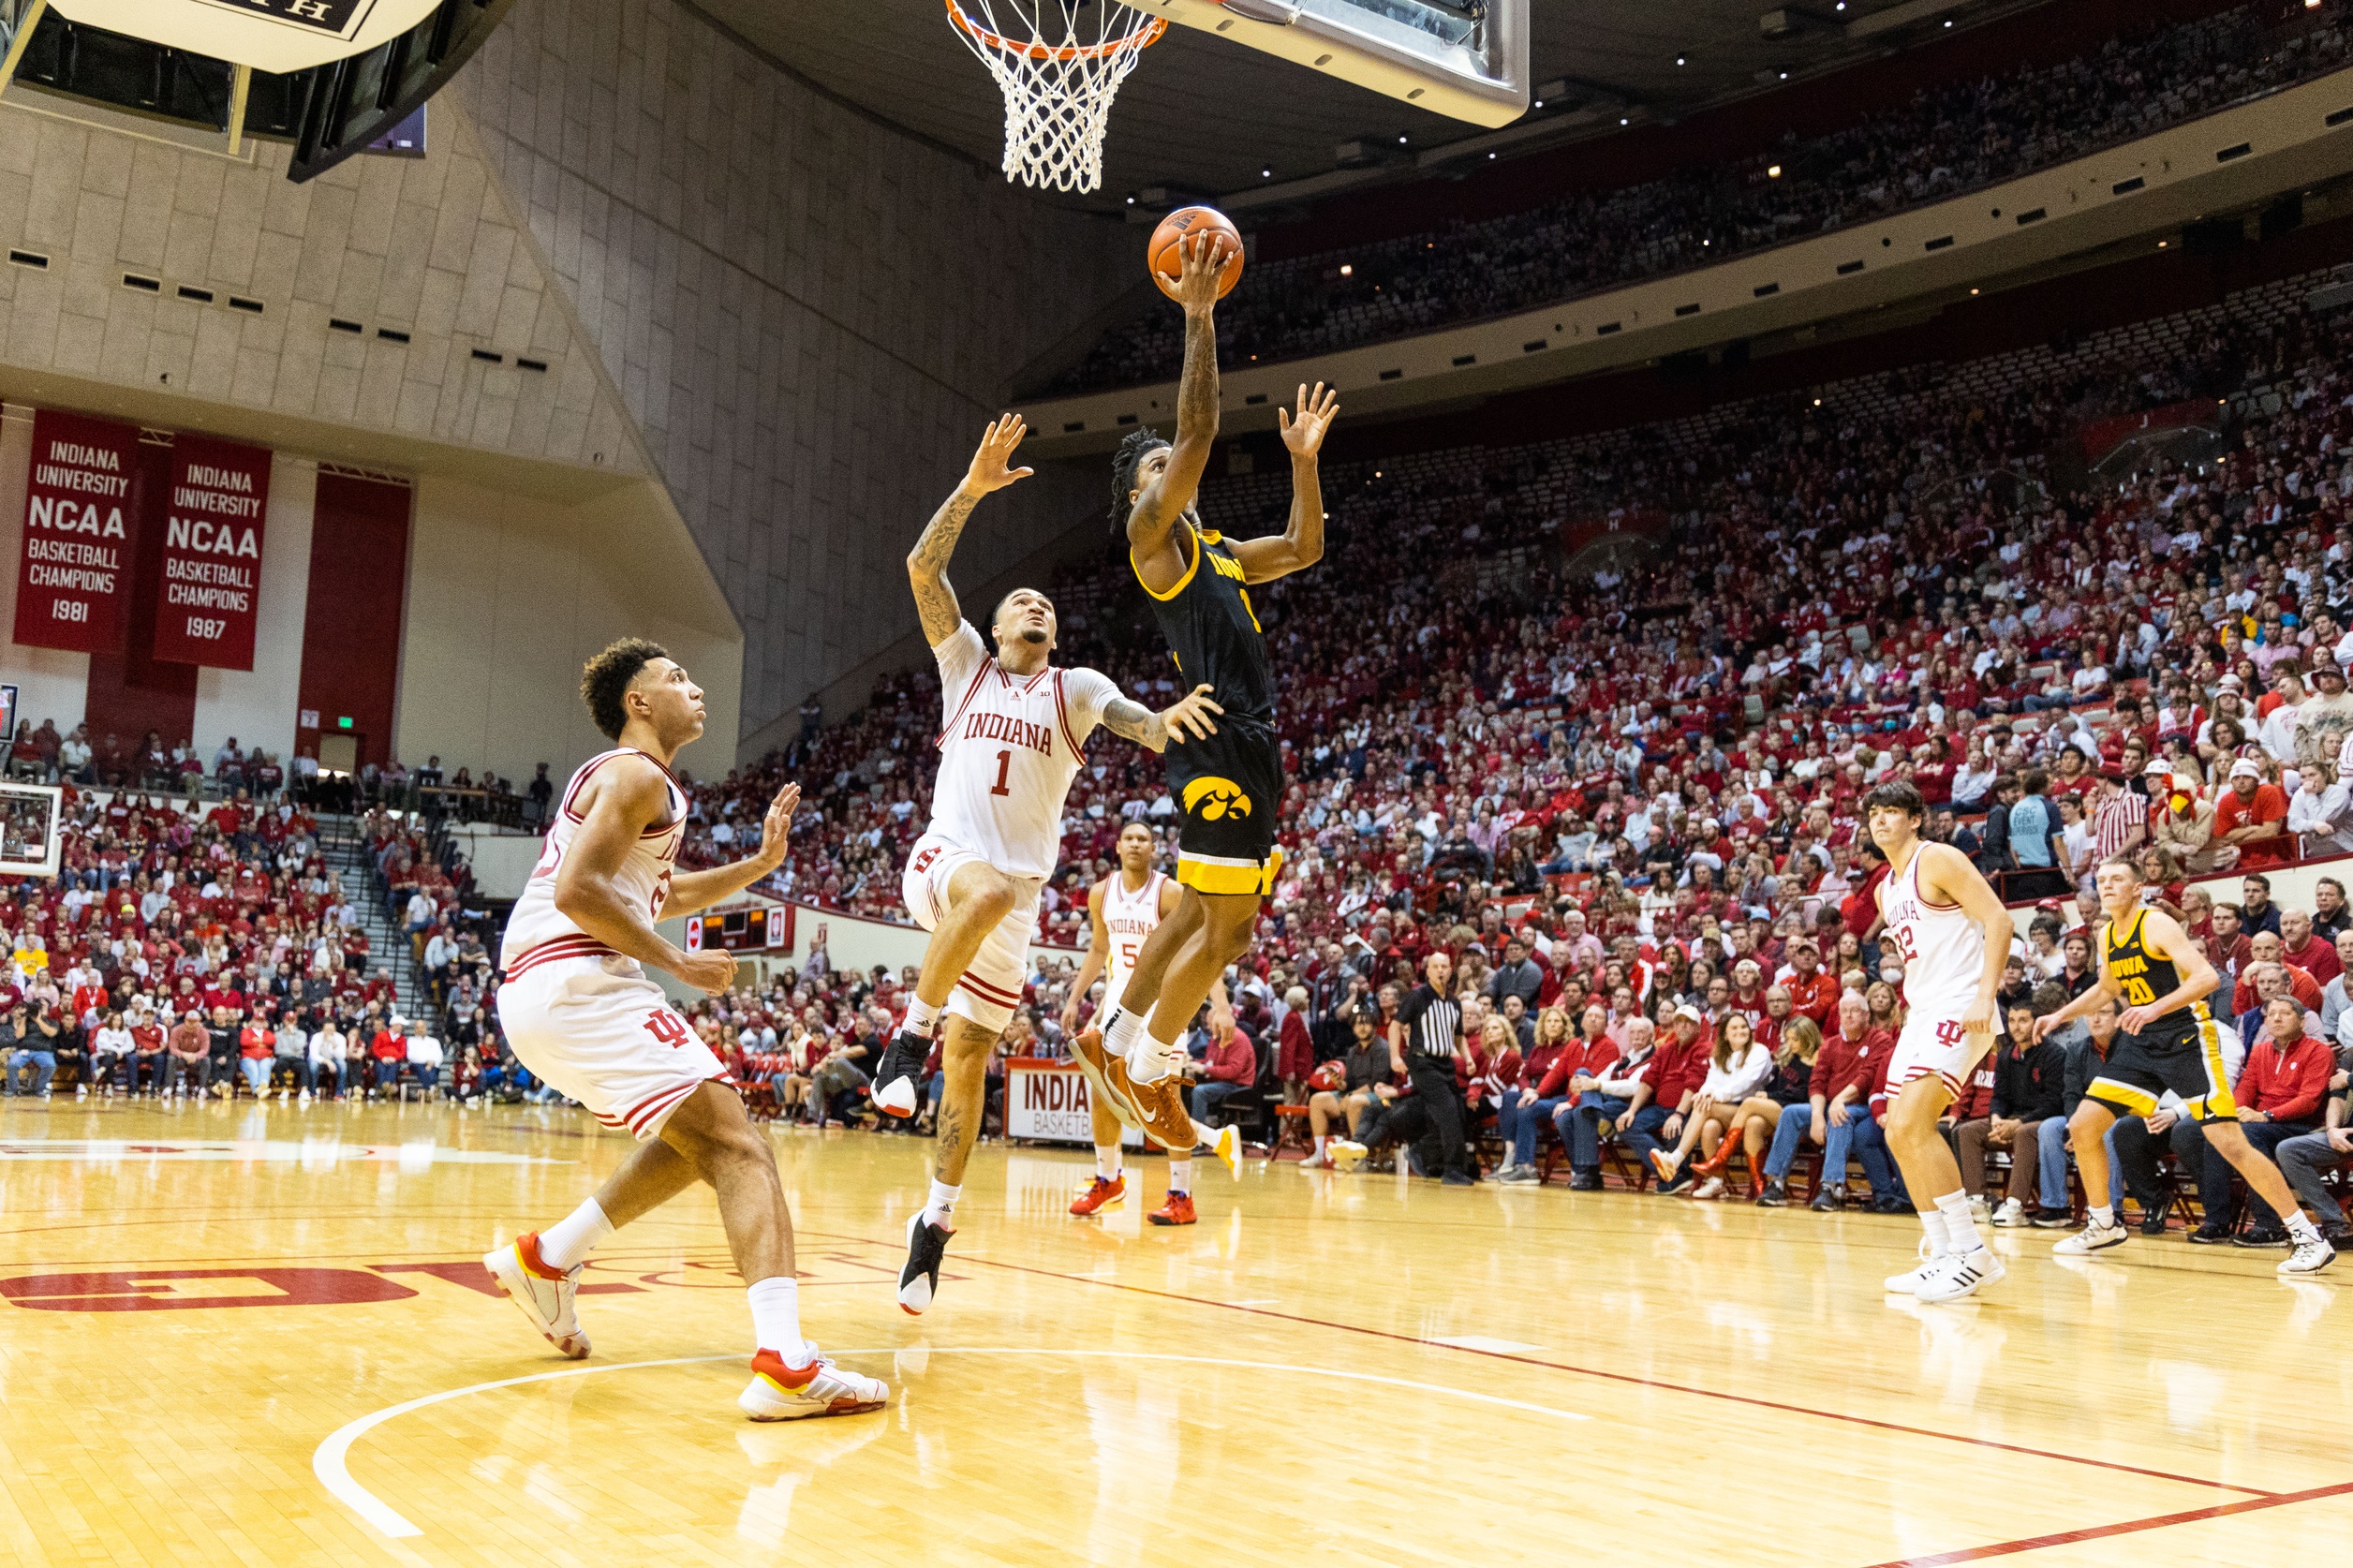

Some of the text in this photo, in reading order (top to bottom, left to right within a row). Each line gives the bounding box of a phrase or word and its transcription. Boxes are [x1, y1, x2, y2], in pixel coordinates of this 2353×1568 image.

[50, 439, 119, 471] INDIANA
[36, 464, 128, 497] UNIVERSITY
[187, 464, 252, 494] INDIANA
[28, 495, 126, 540] NCAA
[174, 486, 260, 518] UNIVERSITY
[167, 516, 258, 559] NCAA
[27, 538, 120, 570] BASKETBALL
[29, 564, 115, 595] CHAMPIONS
[166, 557, 253, 589] BASKETBALL
[52, 599, 88, 623] 1981
[168, 583, 249, 613] CHAMPIONS
[186, 616, 226, 640] 1987
[964, 712, 1052, 758] INDIANA
[990, 749, 1012, 797] 1
[1122, 942, 1138, 969] 5
[1894, 925, 1918, 965] 32
[2109, 954, 2150, 979] IOWA
[2120, 976, 2156, 1006] 20
[1025, 1073, 1089, 1113] INDIA
[1033, 1113, 1092, 1136] BASKETB
